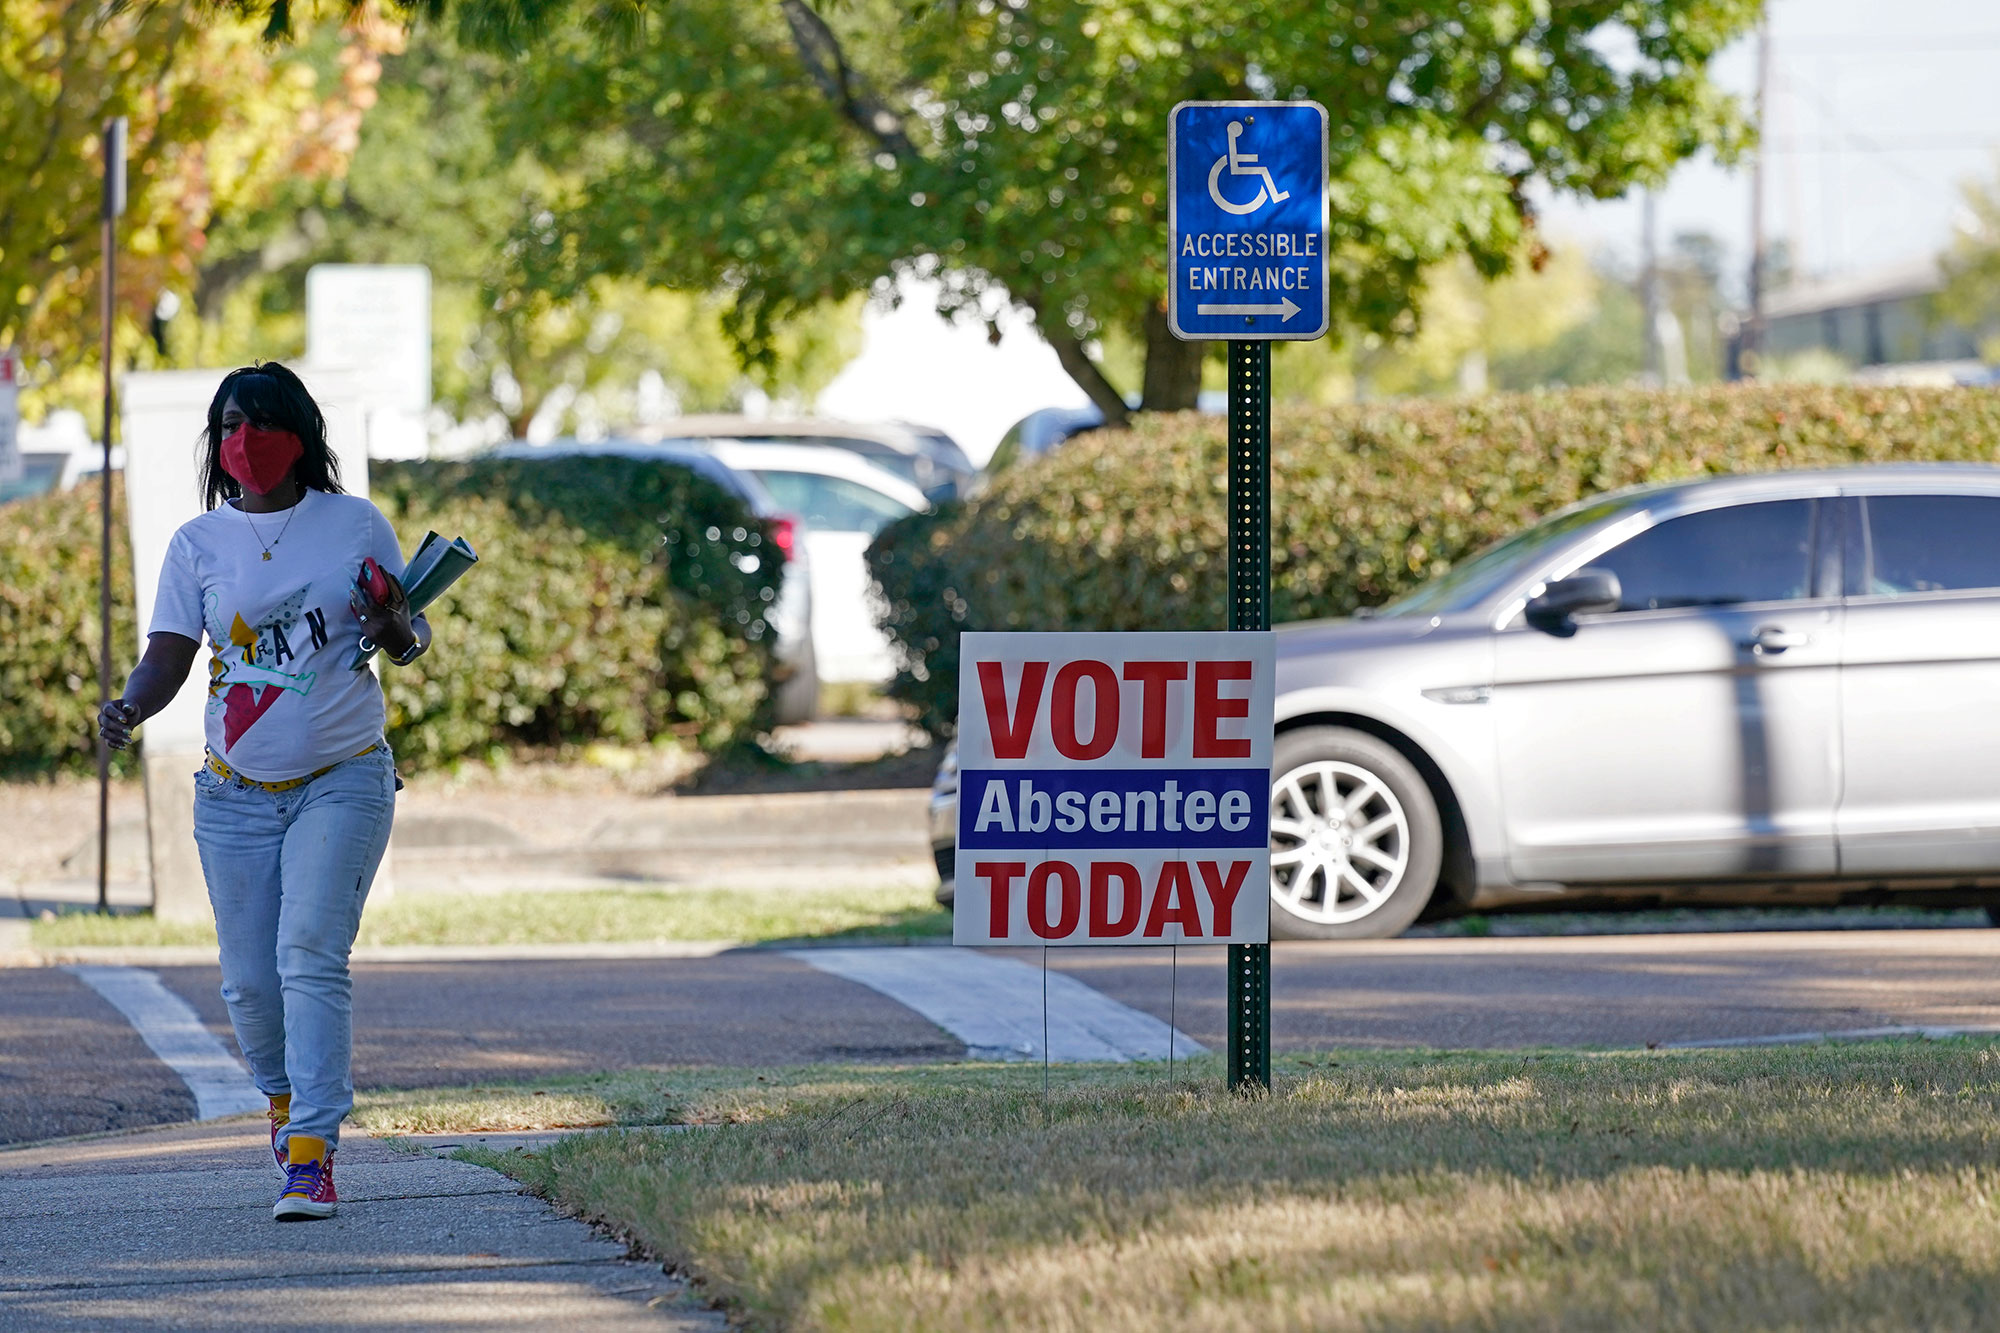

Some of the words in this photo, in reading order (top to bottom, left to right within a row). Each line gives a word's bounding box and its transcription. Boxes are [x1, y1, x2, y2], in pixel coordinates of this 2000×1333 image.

[1181, 233, 1318, 257] ACCESSIBLE
[1189, 267, 1310, 290] ENTRANCE
[976, 659, 1252, 760] VOTE
[974, 779, 1251, 832] Absentee
[975, 860, 1253, 939] TODAY
